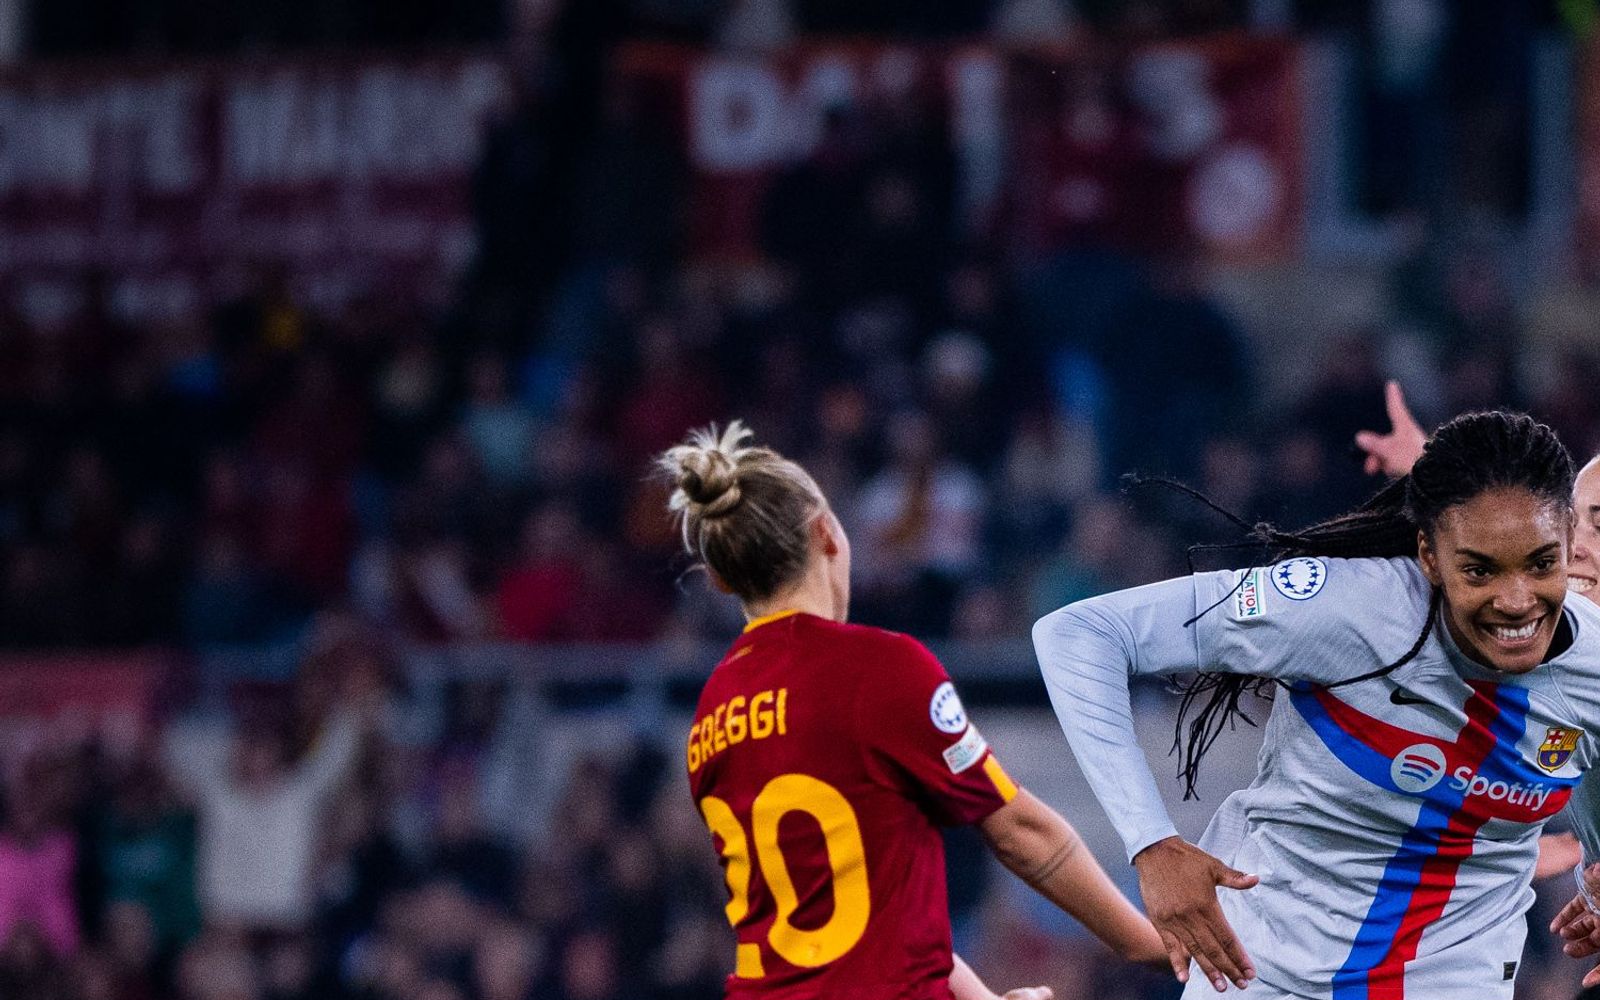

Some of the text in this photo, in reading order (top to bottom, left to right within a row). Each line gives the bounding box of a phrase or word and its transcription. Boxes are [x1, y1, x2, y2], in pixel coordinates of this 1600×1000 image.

[687, 687, 788, 774] GREGGI
[1448, 765, 1553, 812] Spotify
[701, 773, 870, 978] 20
